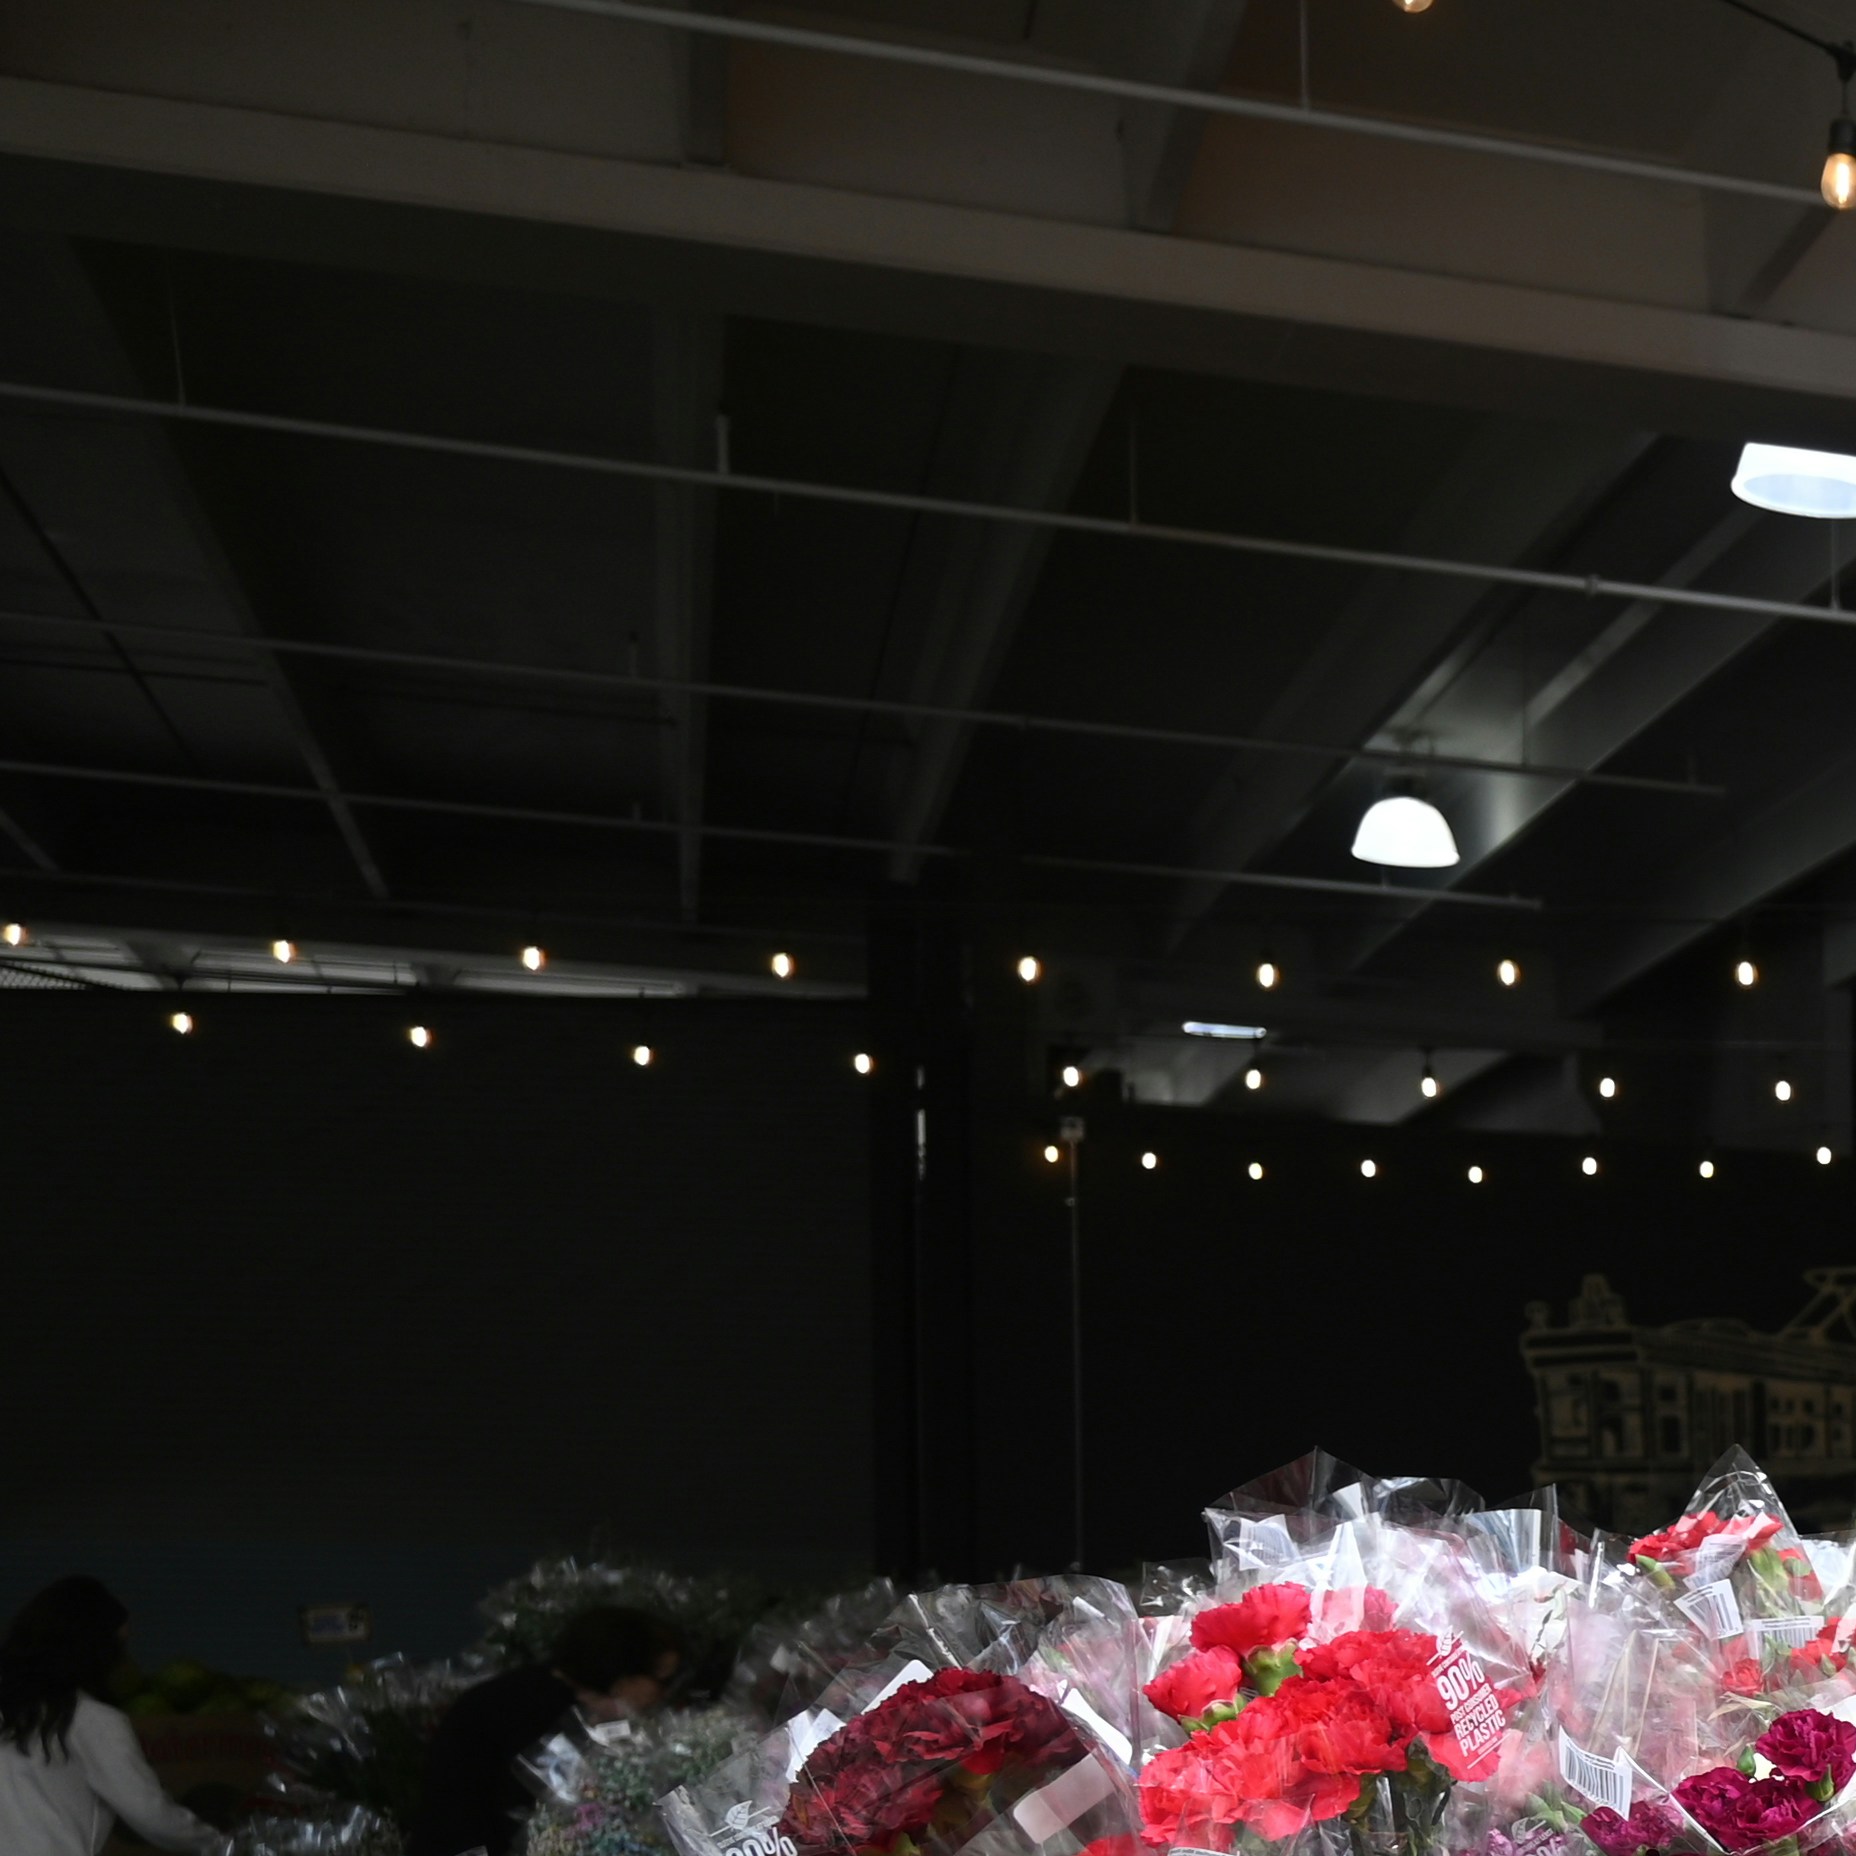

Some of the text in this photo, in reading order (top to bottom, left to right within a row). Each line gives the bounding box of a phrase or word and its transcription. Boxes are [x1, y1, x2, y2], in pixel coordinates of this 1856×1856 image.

[1437, 1651, 1486, 1711] 90%
[1450, 1683, 1492, 1725] POST CONSUMER
[1454, 1699, 1500, 1741] RECYCLED
[1460, 1709, 1506, 1758] PLASTIC
